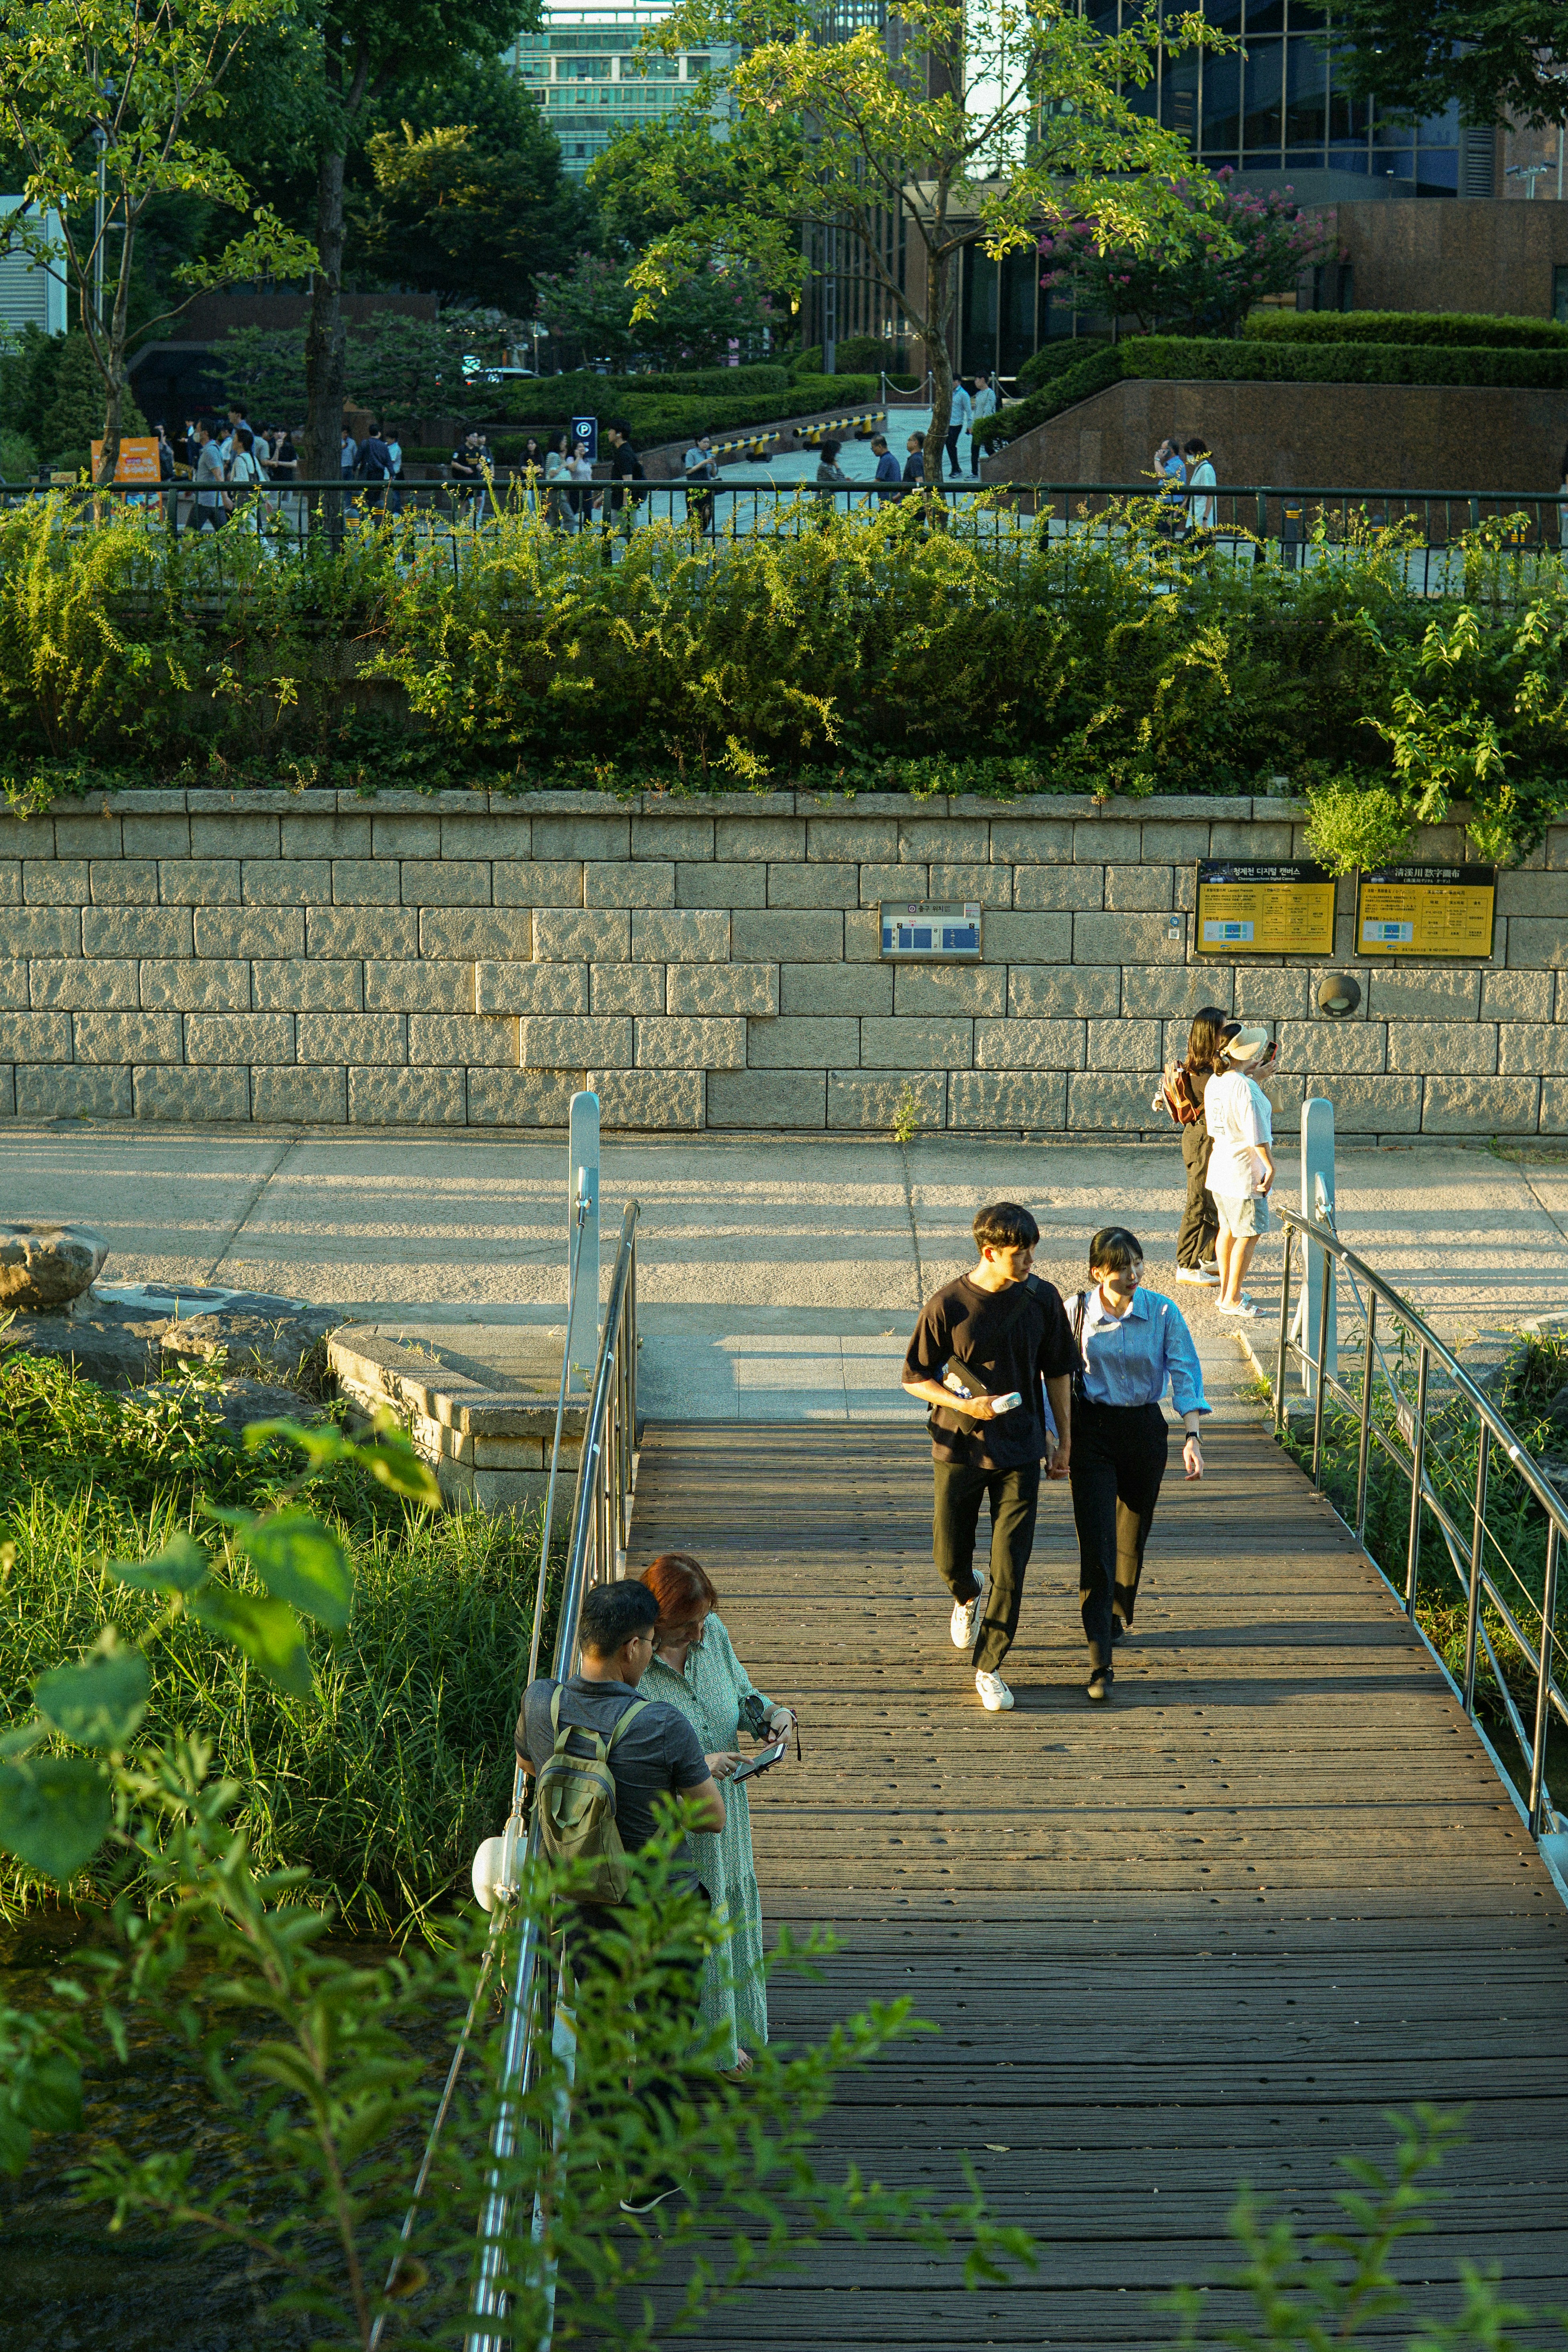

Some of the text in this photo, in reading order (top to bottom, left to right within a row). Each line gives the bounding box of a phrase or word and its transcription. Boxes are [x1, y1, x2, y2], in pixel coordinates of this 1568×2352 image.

[581, 425, 589, 434] P
[1233, 867, 1301, 876] 청계천 디지털 캔버스
